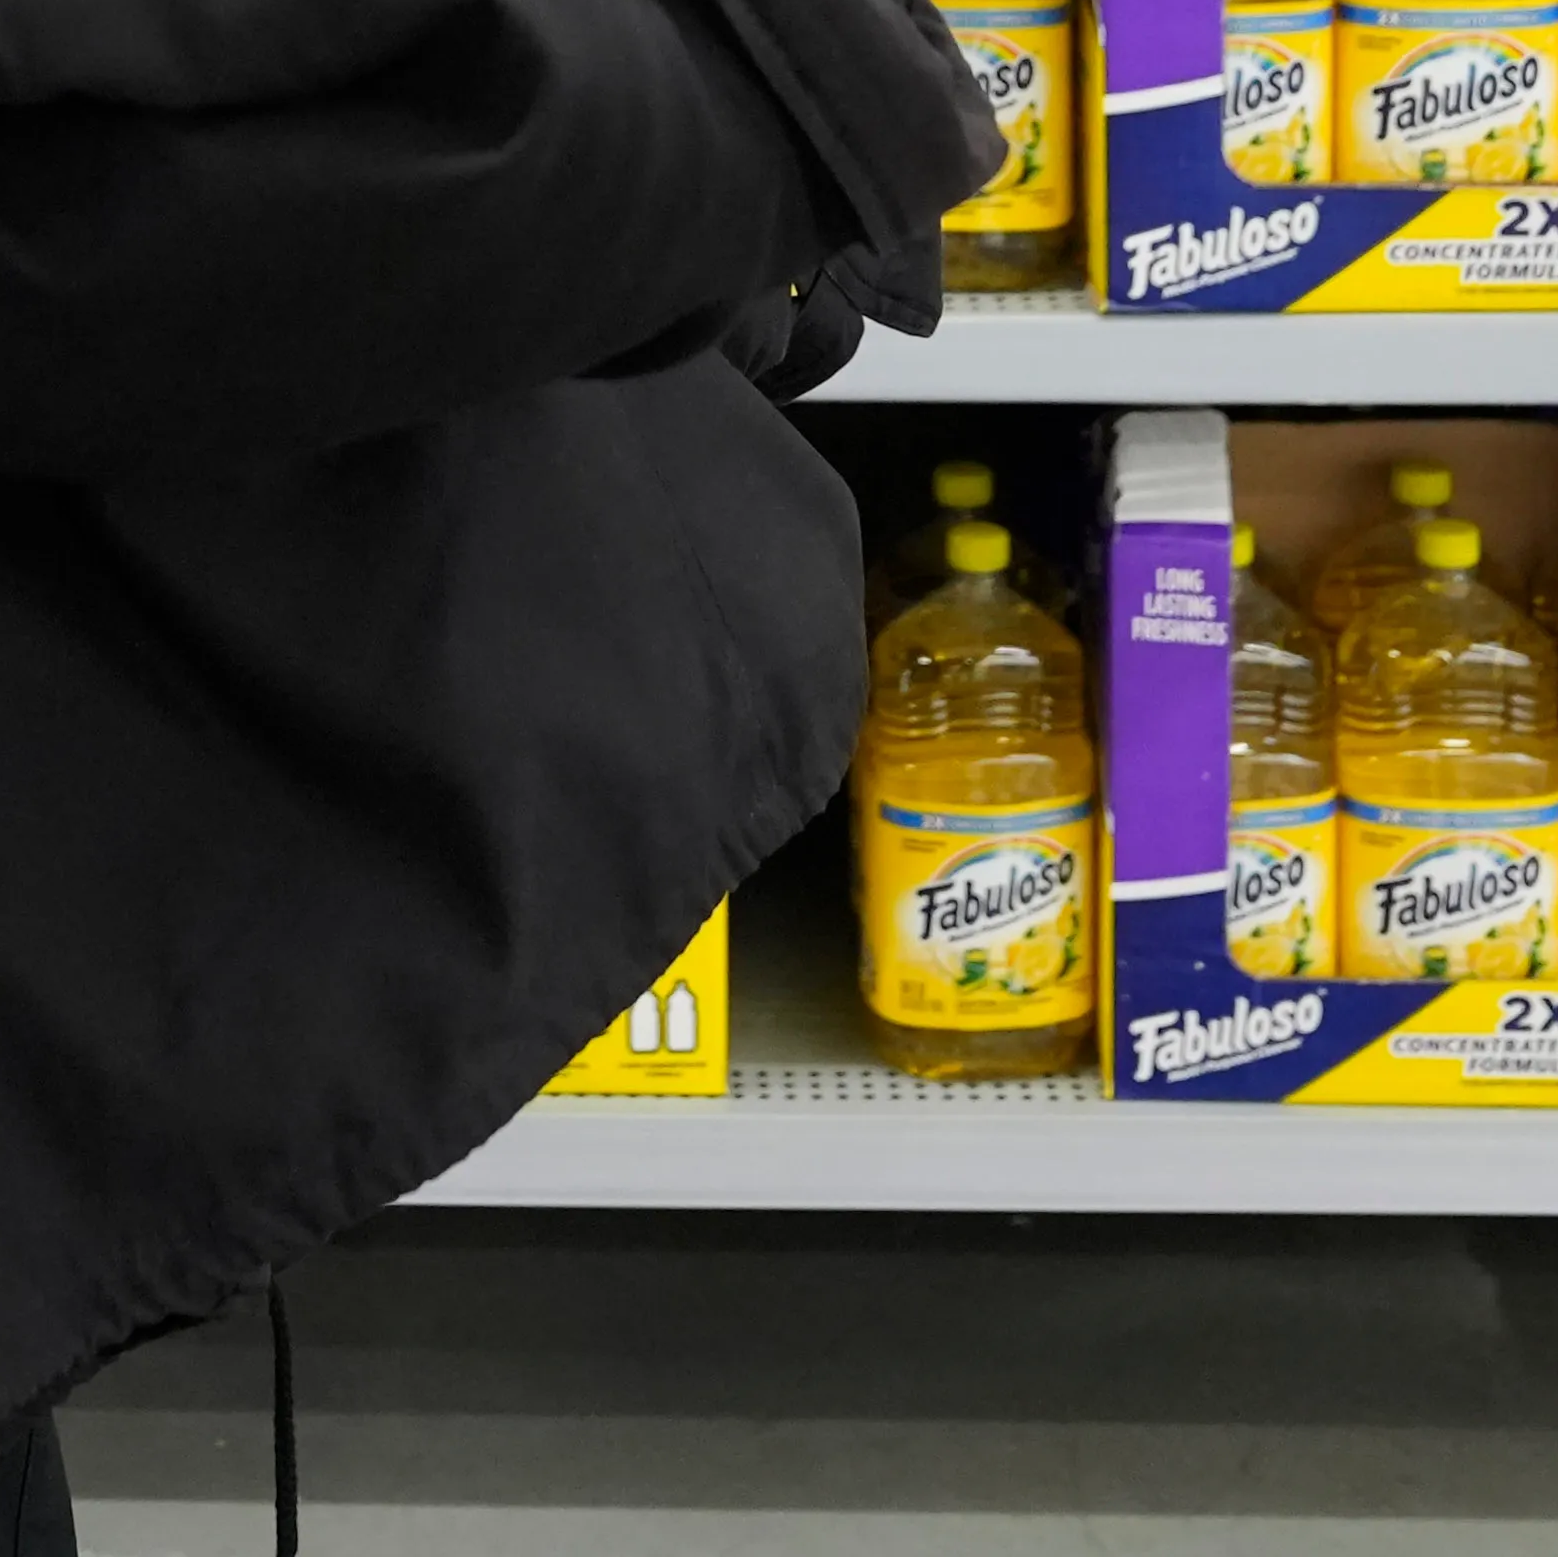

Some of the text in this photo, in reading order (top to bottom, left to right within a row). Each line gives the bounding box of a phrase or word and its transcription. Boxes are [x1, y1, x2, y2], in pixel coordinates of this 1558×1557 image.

[1372, 57, 1539, 141] Fabuloso
[1123, 201, 1320, 301] Fabuloso
[1143, 592, 1217, 619] LASTING
[1155, 567, 1206, 592] LONG
[1131, 617, 1230, 647] FRESHNESS
[916, 850, 1076, 943] Fabuloso
[1375, 856, 1540, 935] Fabuloso
[1130, 994, 1325, 1084] Fabuloso
